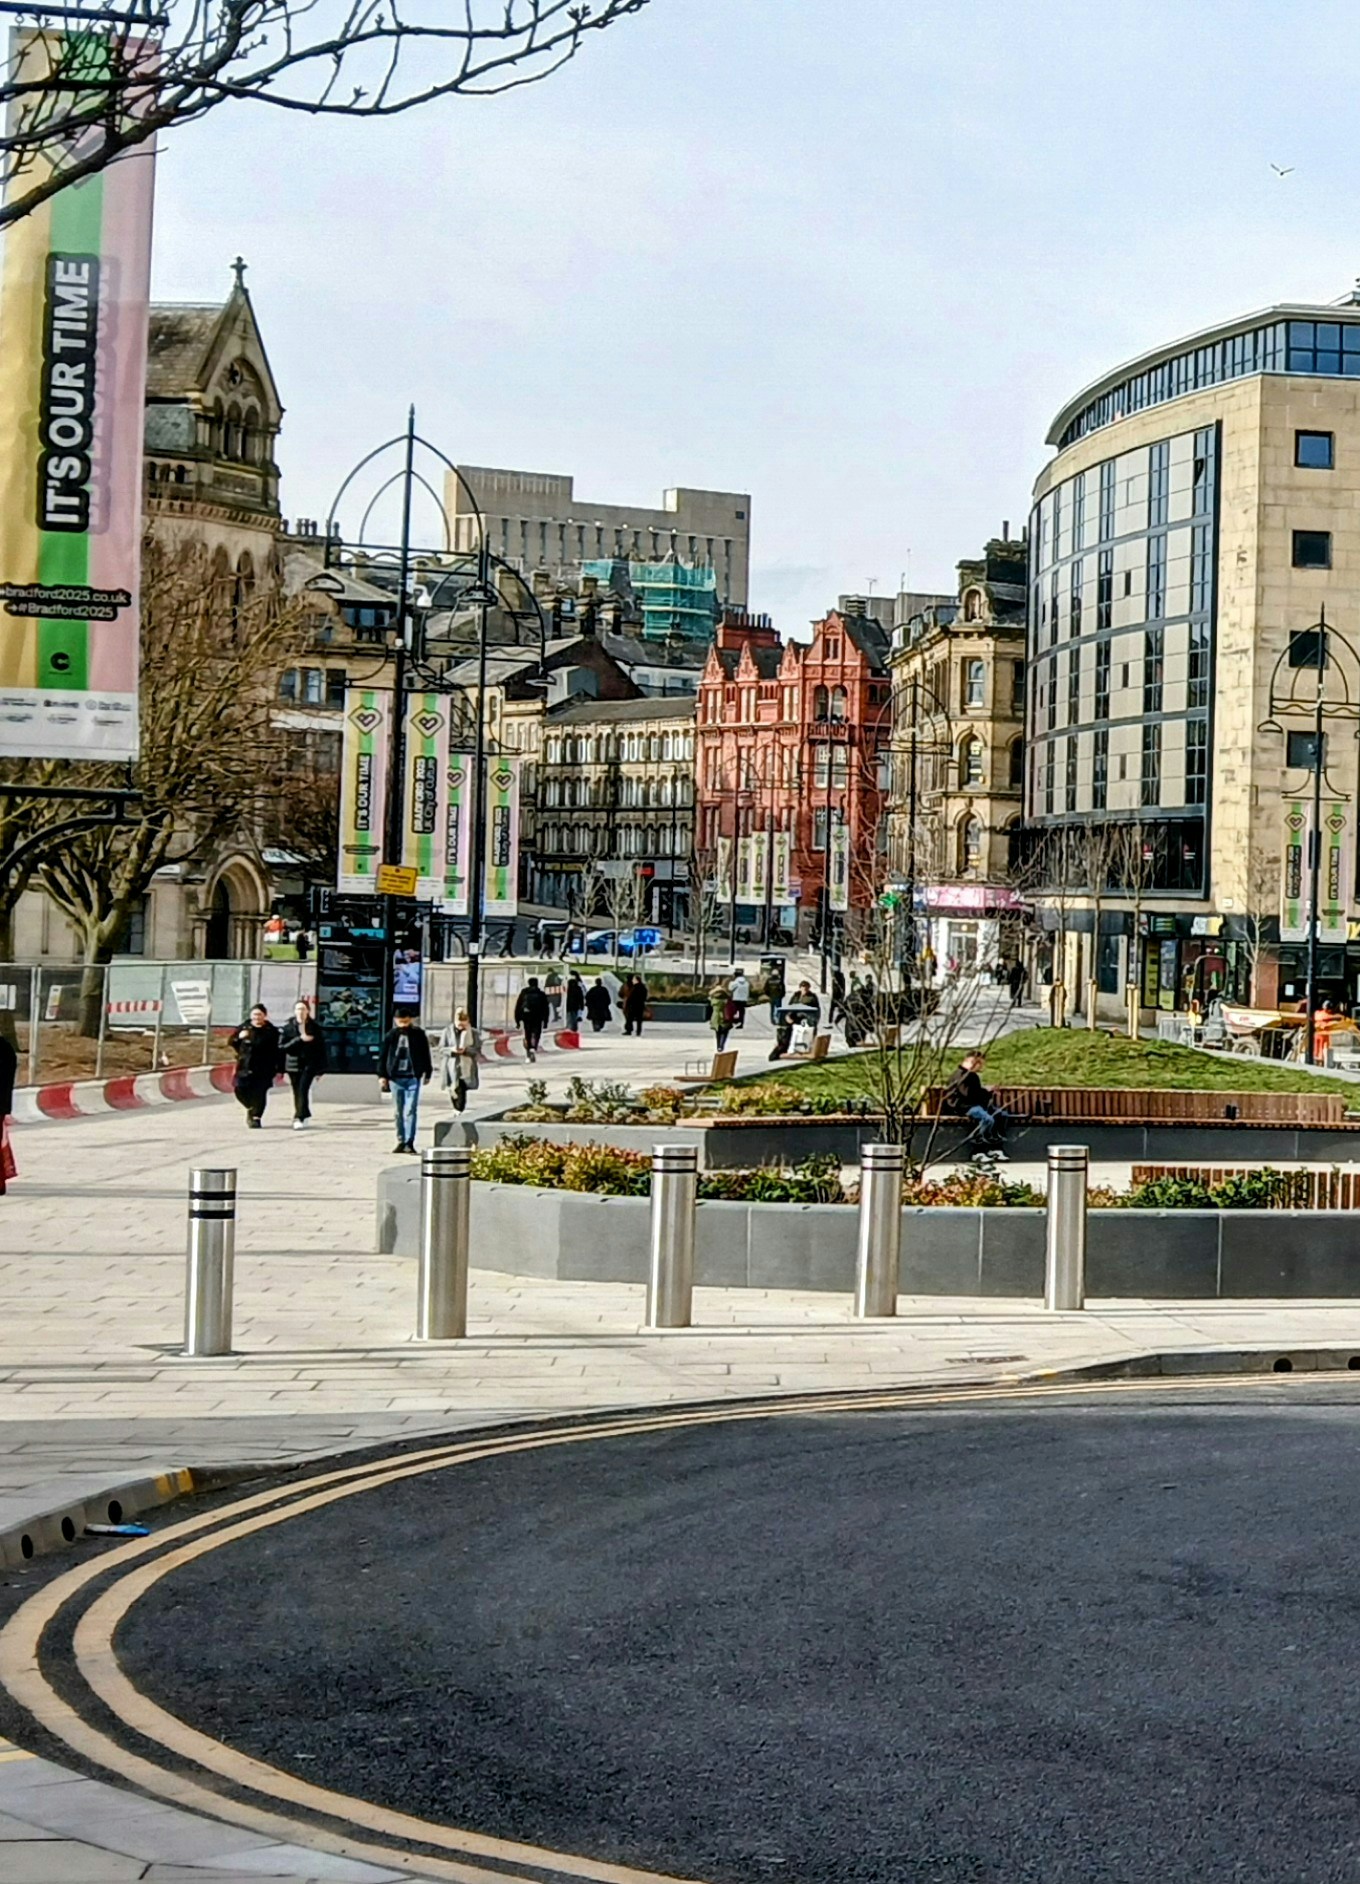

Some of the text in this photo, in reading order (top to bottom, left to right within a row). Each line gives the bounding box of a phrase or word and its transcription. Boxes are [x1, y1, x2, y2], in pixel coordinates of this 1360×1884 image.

[45, 260, 90, 524] IT'S OUR TIME
[5, 587, 128, 603] bradford2025.co.uk
